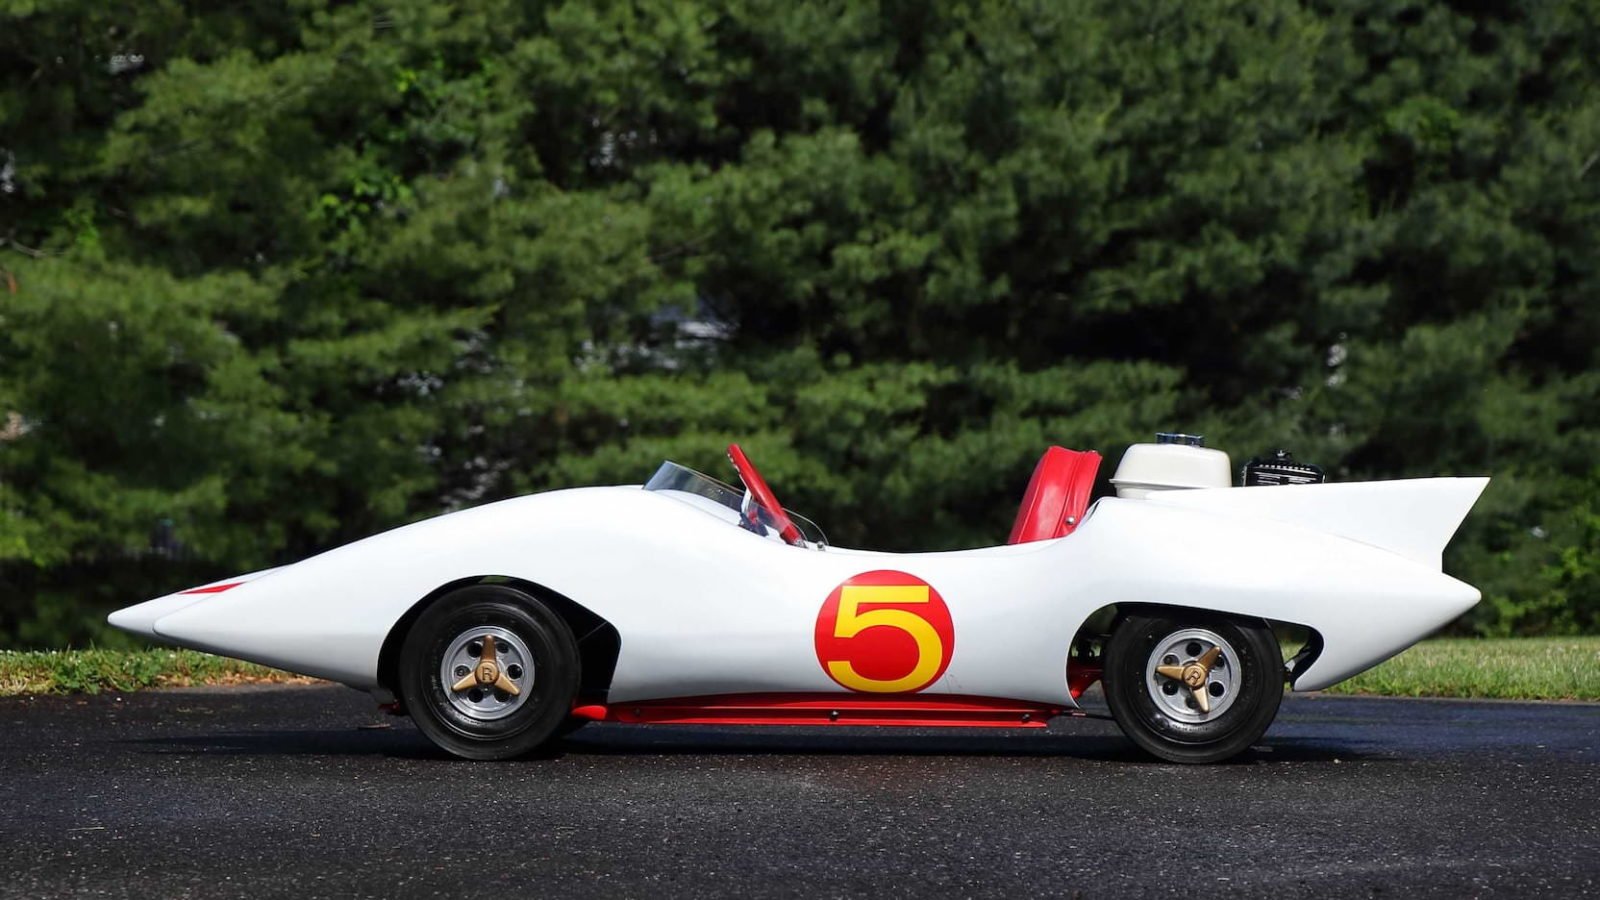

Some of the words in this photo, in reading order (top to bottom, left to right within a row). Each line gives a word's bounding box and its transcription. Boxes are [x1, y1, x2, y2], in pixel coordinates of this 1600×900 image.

[827, 585, 943, 693] 5
[482, 667, 493, 681] R
[1186, 669, 1201, 685] R
